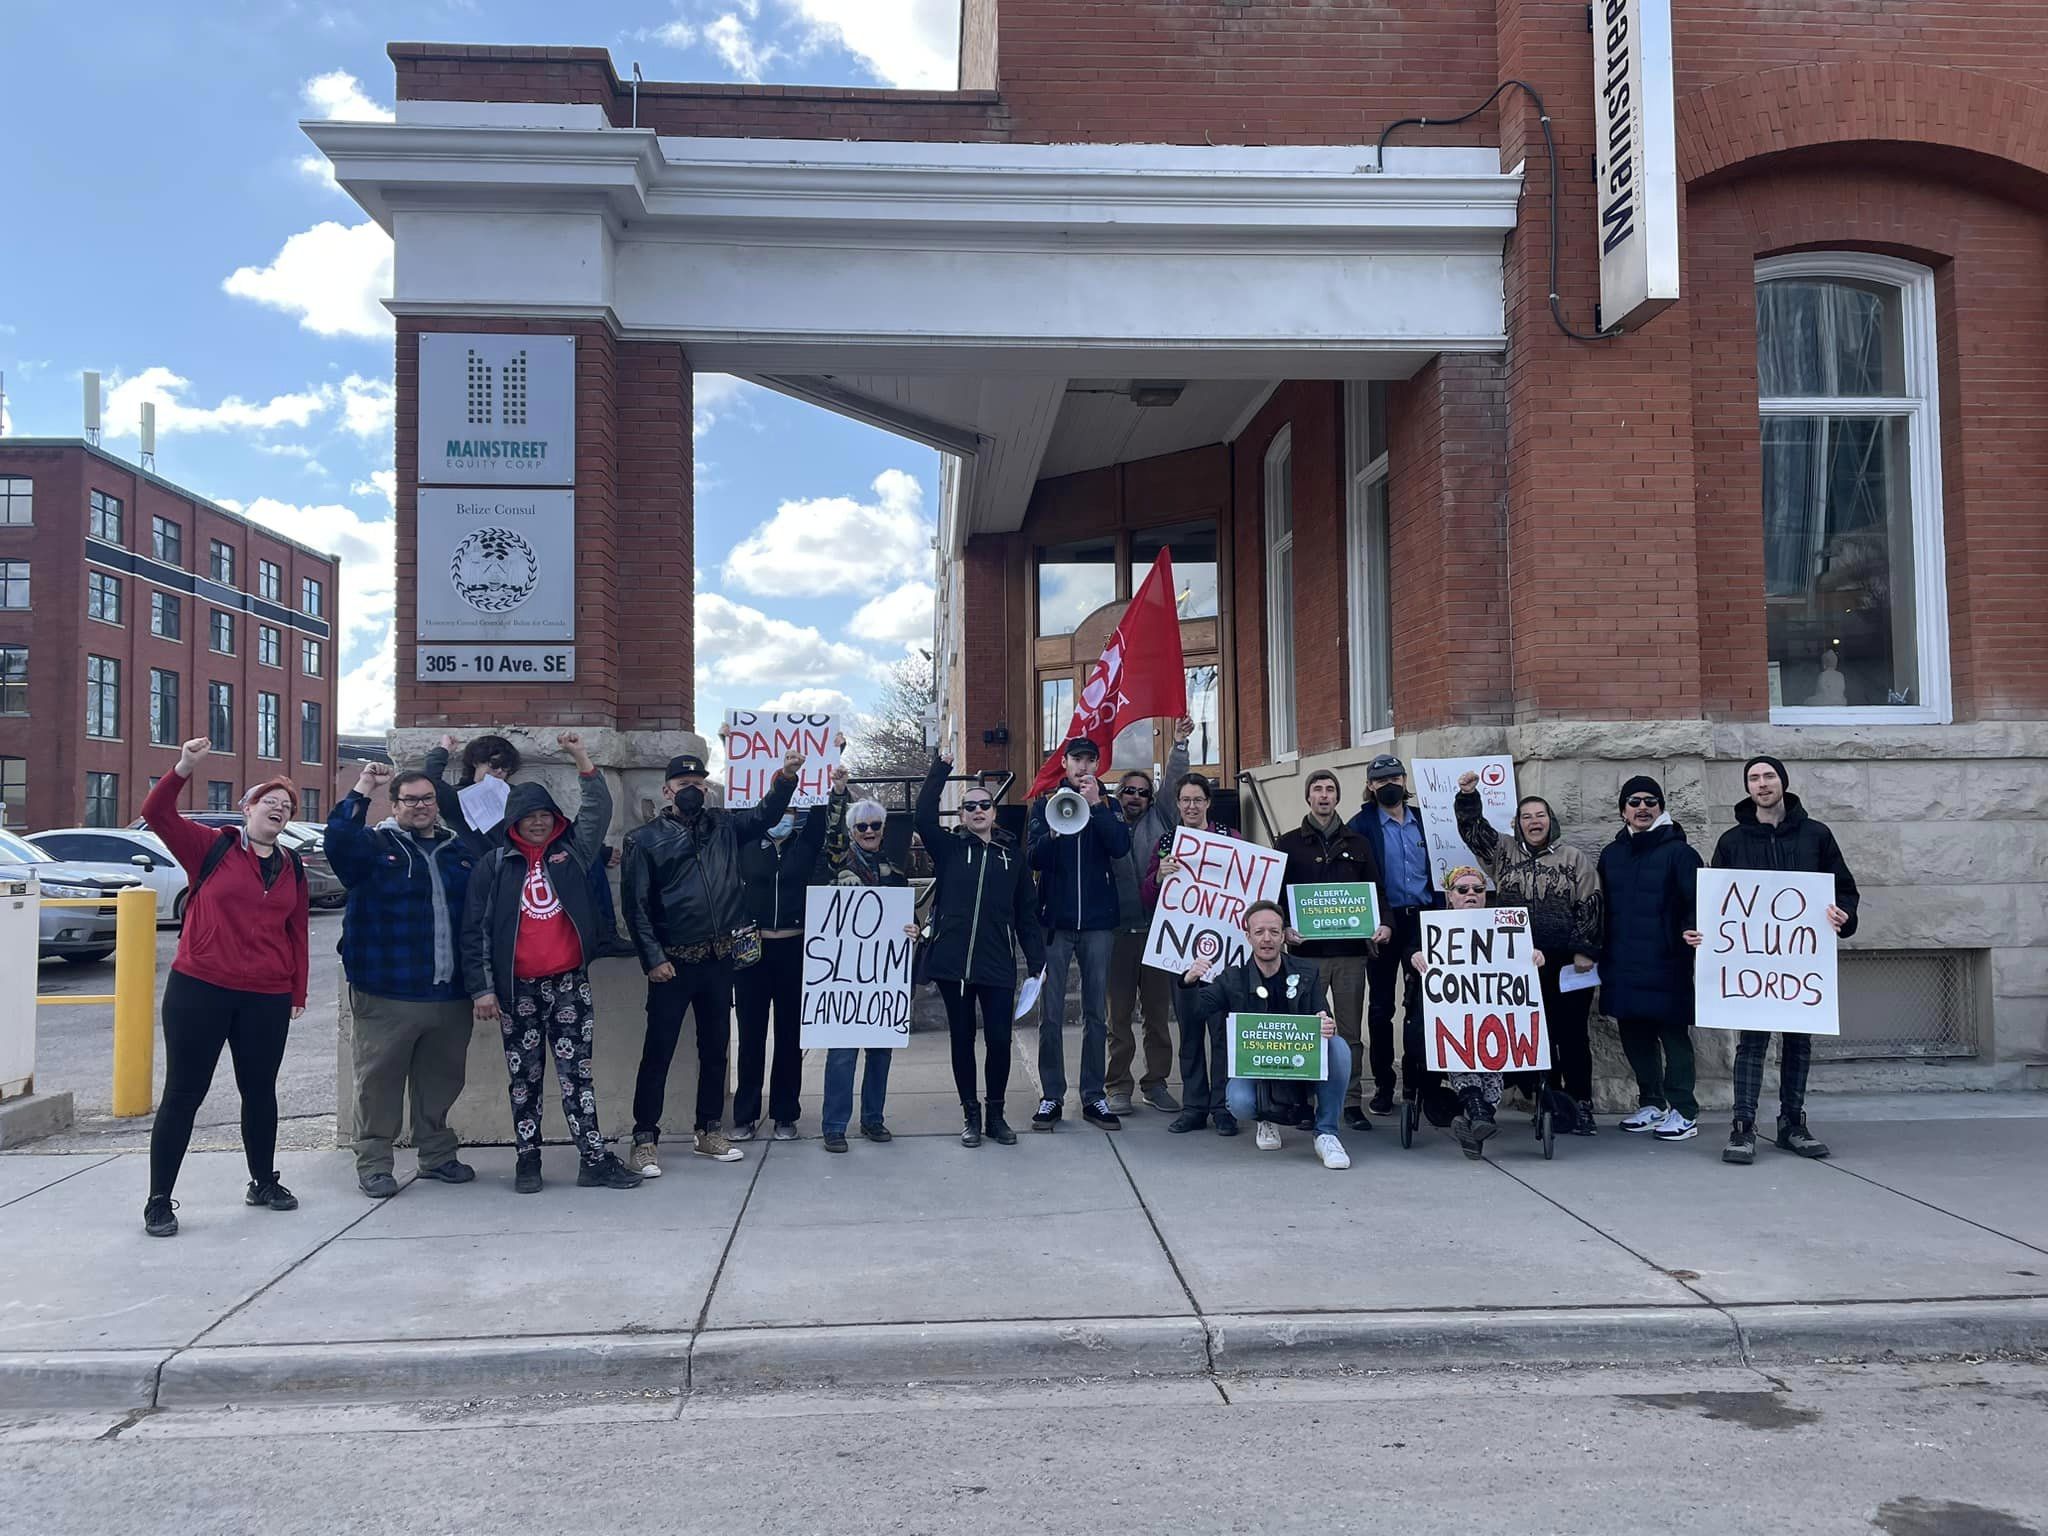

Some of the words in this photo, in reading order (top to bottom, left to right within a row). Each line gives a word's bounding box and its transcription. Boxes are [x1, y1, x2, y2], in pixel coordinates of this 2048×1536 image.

[1602, 0, 1634, 257] Mainstree
[1633, 156, 1641, 212] EQUITY
[446, 440, 548, 459] MAINSTREET
[446, 460, 497, 469] EQUITY
[505, 460, 542, 469] CORP
[456, 503, 491, 515] Belize
[494, 503, 536, 516] Consul
[426, 656, 457, 672] 305
[474, 656, 494, 672] 10
[499, 656, 538, 672] Ave.
[543, 656, 567, 672] SE
[728, 727, 829, 760] DAMN
[728, 764, 833, 801] HIH!
[1175, 834, 1280, 902] RENT
[1162, 877, 1249, 931] CONTR
[1300, 898, 1337, 906] GREENS
[1339, 896, 1366, 905] WANT
[1313, 889, 1350, 897] ALBERTA
[1323, 906, 1346, 914] RENT
[1348, 905, 1367, 913] CAP
[1721, 882, 1807, 922] NO
[820, 889, 884, 939] NO
[1312, 917, 1347, 929] green
[805, 936, 911, 986] SLUM
[1426, 924, 1526, 965] RENT
[1424, 967, 1539, 1008] CONTROL
[1720, 966, 1824, 1006] LORDS
[801, 990, 911, 1034] LANDLORDS
[1257, 1022, 1298, 1030] ALBERTA
[1241, 1030, 1283, 1041] GREENS
[1285, 1032, 1316, 1041] WANT
[1243, 1041, 1265, 1050] 1.5%
[1266, 1042, 1292, 1051] RENT
[1294, 1042, 1315, 1051] CAP
[1435, 1010, 1540, 1072] NOW
[1252, 1055, 1290, 1066] green
